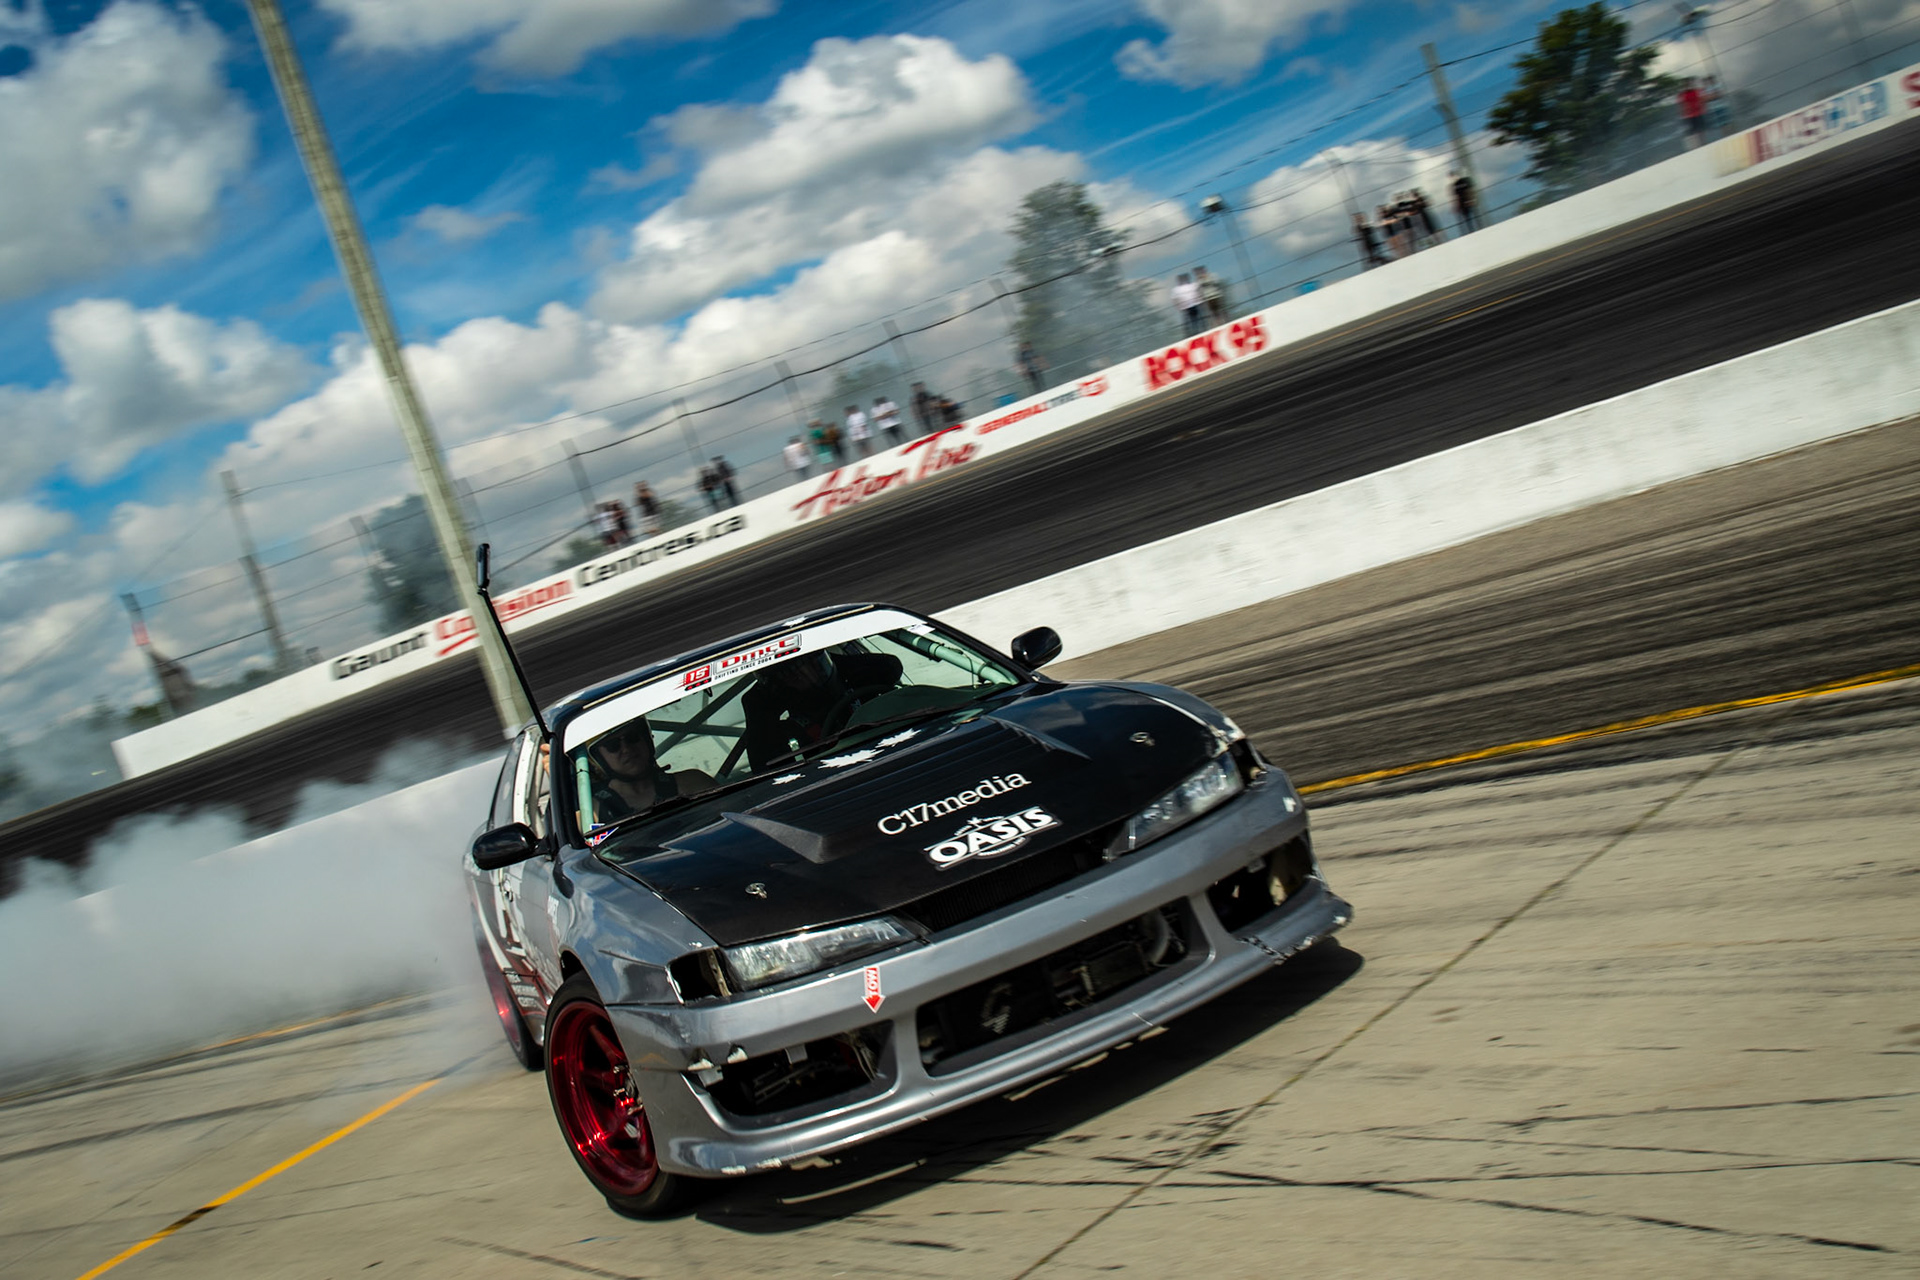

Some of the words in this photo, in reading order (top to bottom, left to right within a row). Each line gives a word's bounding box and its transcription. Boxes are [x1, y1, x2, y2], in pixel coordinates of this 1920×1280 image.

[1143, 330, 1230, 391] ROCK
[332, 631, 428, 681] Gaunt
[436, 579, 571, 641] Coision
[577, 514, 748, 588] Centres.ca
[740, 662, 756, 671] SINCE
[877, 773, 1032, 835] C17media
[929, 807, 1055, 863] OASIS
